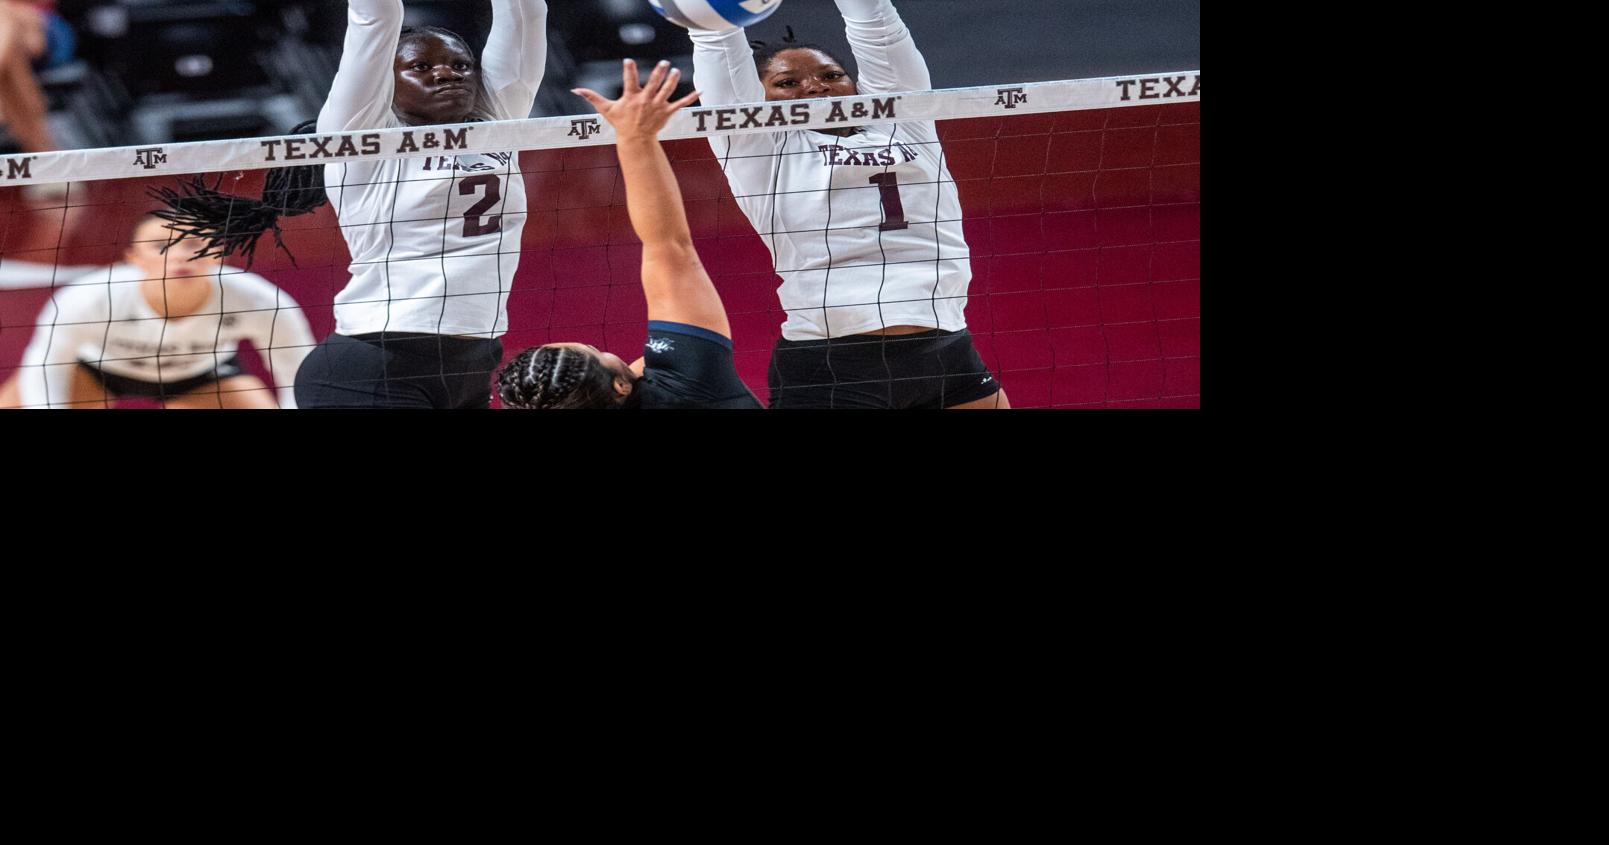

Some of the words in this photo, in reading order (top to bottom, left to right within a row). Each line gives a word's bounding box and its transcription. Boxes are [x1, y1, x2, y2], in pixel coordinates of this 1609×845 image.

[692, 103, 810, 132] TEXAS
[825, 96, 897, 123] A&M
[261, 133, 381, 162] TEXAS
[396, 127, 468, 153] A&M
[818, 144, 896, 166] TEXAS
[0, 157, 32, 180] M
[458, 174, 501, 237] 2
[869, 172, 908, 231] 1
